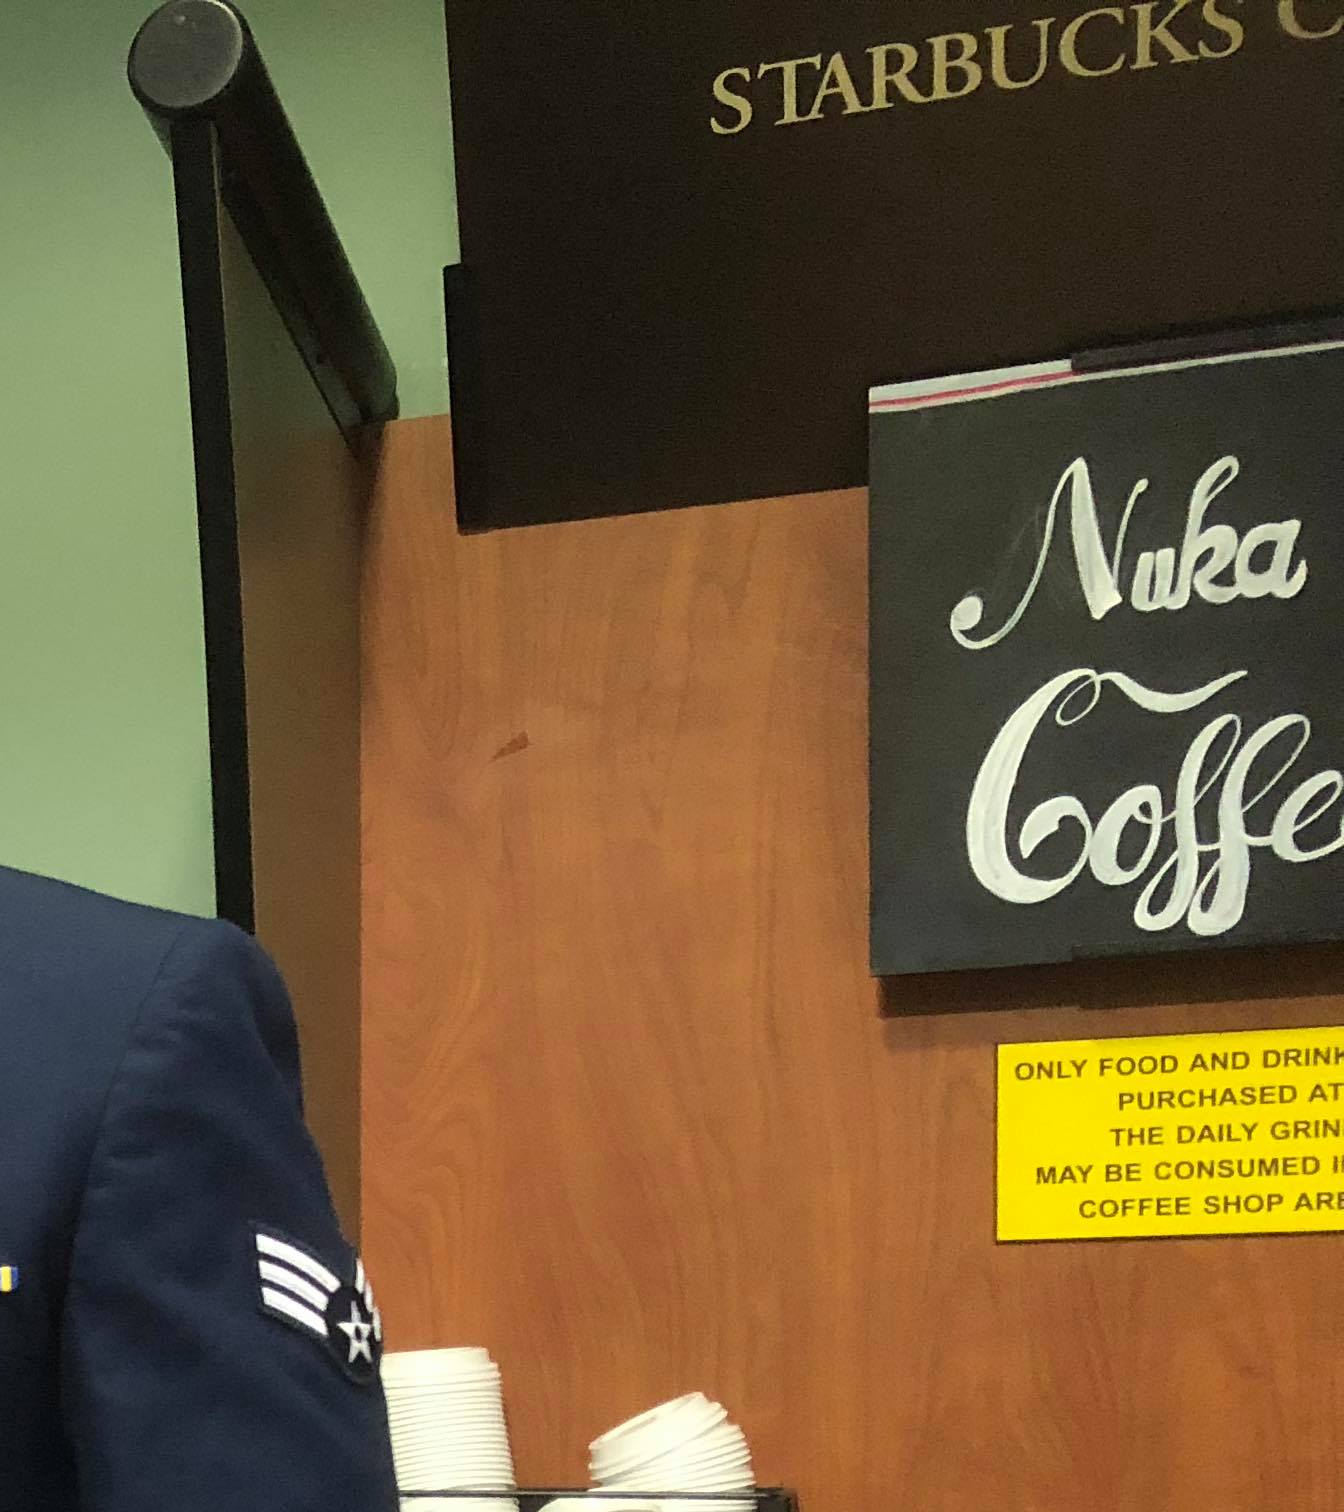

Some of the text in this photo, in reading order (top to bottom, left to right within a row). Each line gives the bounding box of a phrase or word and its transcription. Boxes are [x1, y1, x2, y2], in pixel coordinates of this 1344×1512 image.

[710, 0, 1243, 136] STARBUCKS
[949, 455, 1308, 650] Nuka
[965, 667, 1344, 936] Coffe
[1015, 1059, 1087, 1081] ONLY
[1099, 1055, 1178, 1077] FOOD
[1189, 1051, 1250, 1073] AND
[1118, 1083, 1344, 1111] PURCHASED AT
[1110, 1119, 1344, 1147] THE DAILY GRIN
[1036, 1165, 1094, 1185] MAY
[1105, 1163, 1141, 1183] BE
[1154, 1157, 1320, 1180] CONSUMED
[1079, 1197, 1191, 1219] COFFEE
[1204, 1194, 1284, 1215] SHOP
